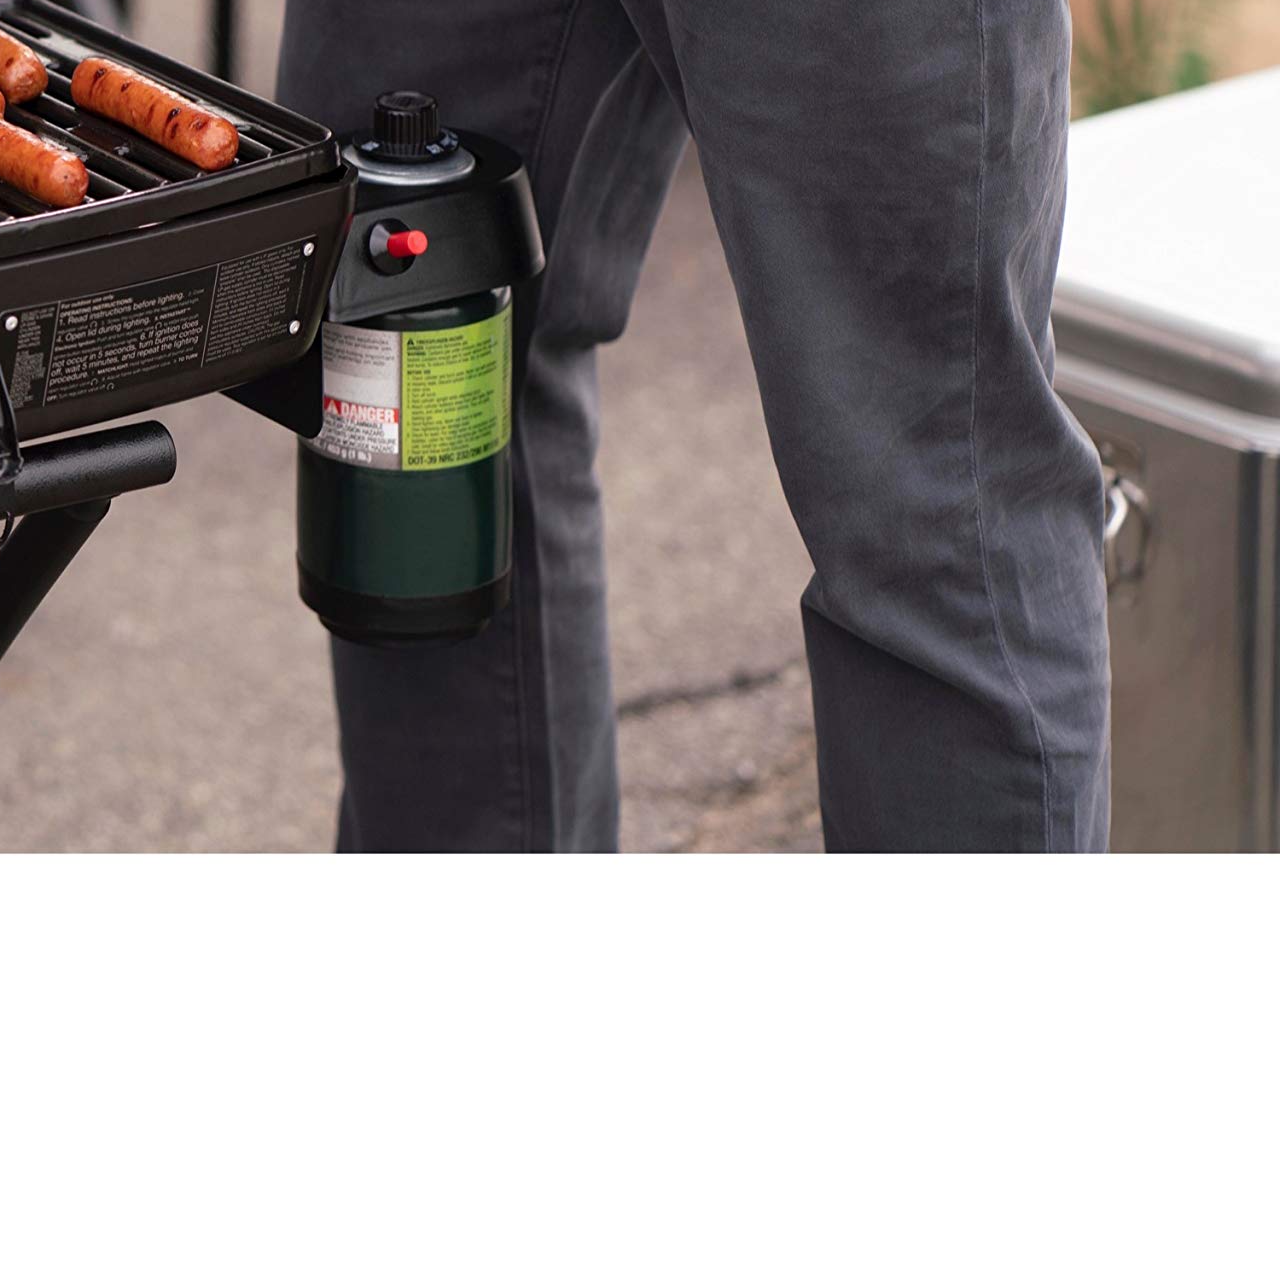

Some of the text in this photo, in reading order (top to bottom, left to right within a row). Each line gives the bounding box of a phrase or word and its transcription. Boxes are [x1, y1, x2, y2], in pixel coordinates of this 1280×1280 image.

[67, 312, 88, 325] Read
[88, 303, 132, 321] instructions
[132, 298, 156, 310] before
[156, 291, 184, 306] lighting.
[64, 328, 86, 343] Open
[86, 326, 97, 337] lid
[97, 322, 122, 336] during
[121, 316, 151, 331] lighting.
[139, 319, 199, 341] 6. If ignition does
[51, 358, 65, 369] not
[65, 355, 88, 366] occur
[88, 351, 96, 361] in
[138, 338, 153, 349] turn
[154, 333, 177, 345] burner
[178, 326, 203, 339] control
[64, 364, 81, 375] wait
[121, 350, 135, 361] and
[135, 346, 159, 359] repeat
[160, 341, 173, 352] the
[172, 335, 199, 350] lighting
[341, 401, 395, 423] DANGER
[407, 455, 437, 465] DOT-39
[439, 453, 455, 463] NRC
